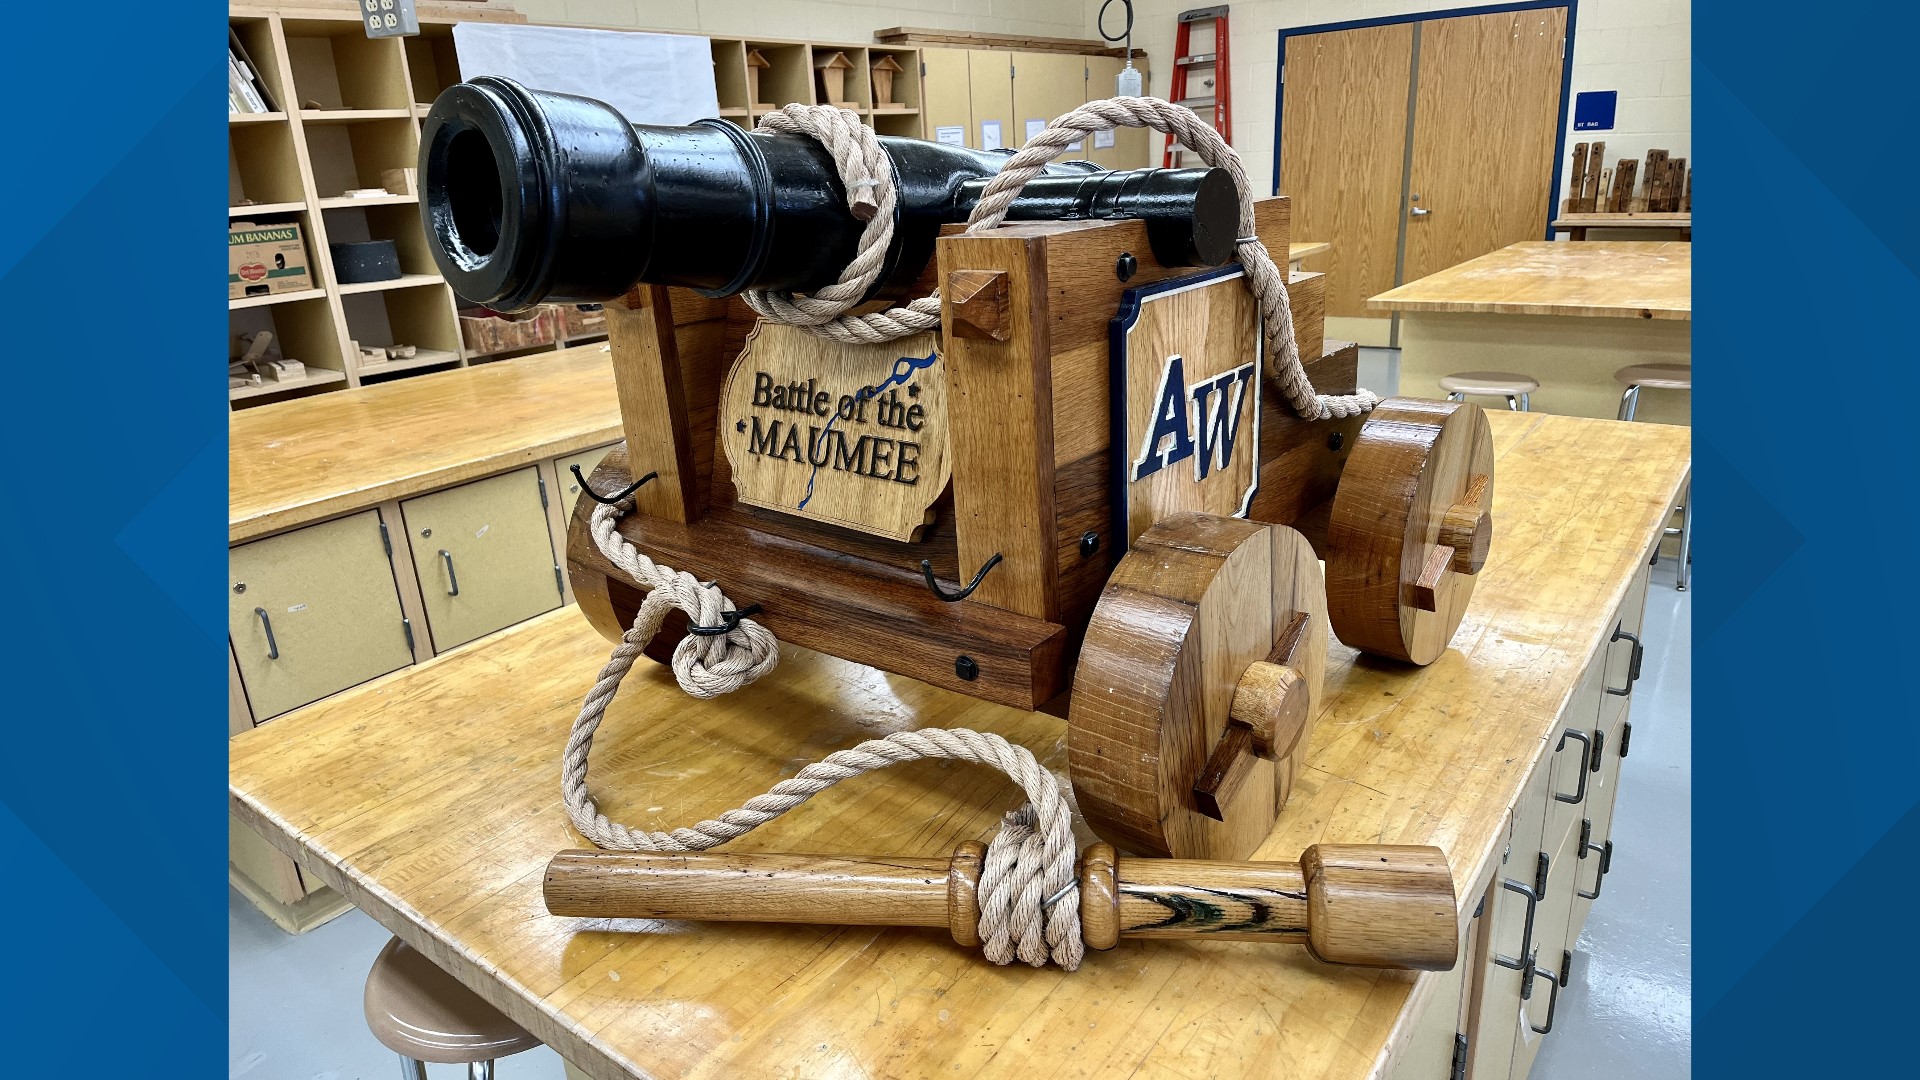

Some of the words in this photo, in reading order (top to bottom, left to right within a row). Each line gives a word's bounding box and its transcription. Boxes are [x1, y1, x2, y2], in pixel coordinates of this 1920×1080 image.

[246, 230, 293, 242] BANANAS
[752, 371, 830, 417] Battle
[838, 384, 876, 424] of
[877, 388, 924, 431] the
[1130, 353, 1254, 483] AW
[748, 416, 921, 485] MAUMEE
